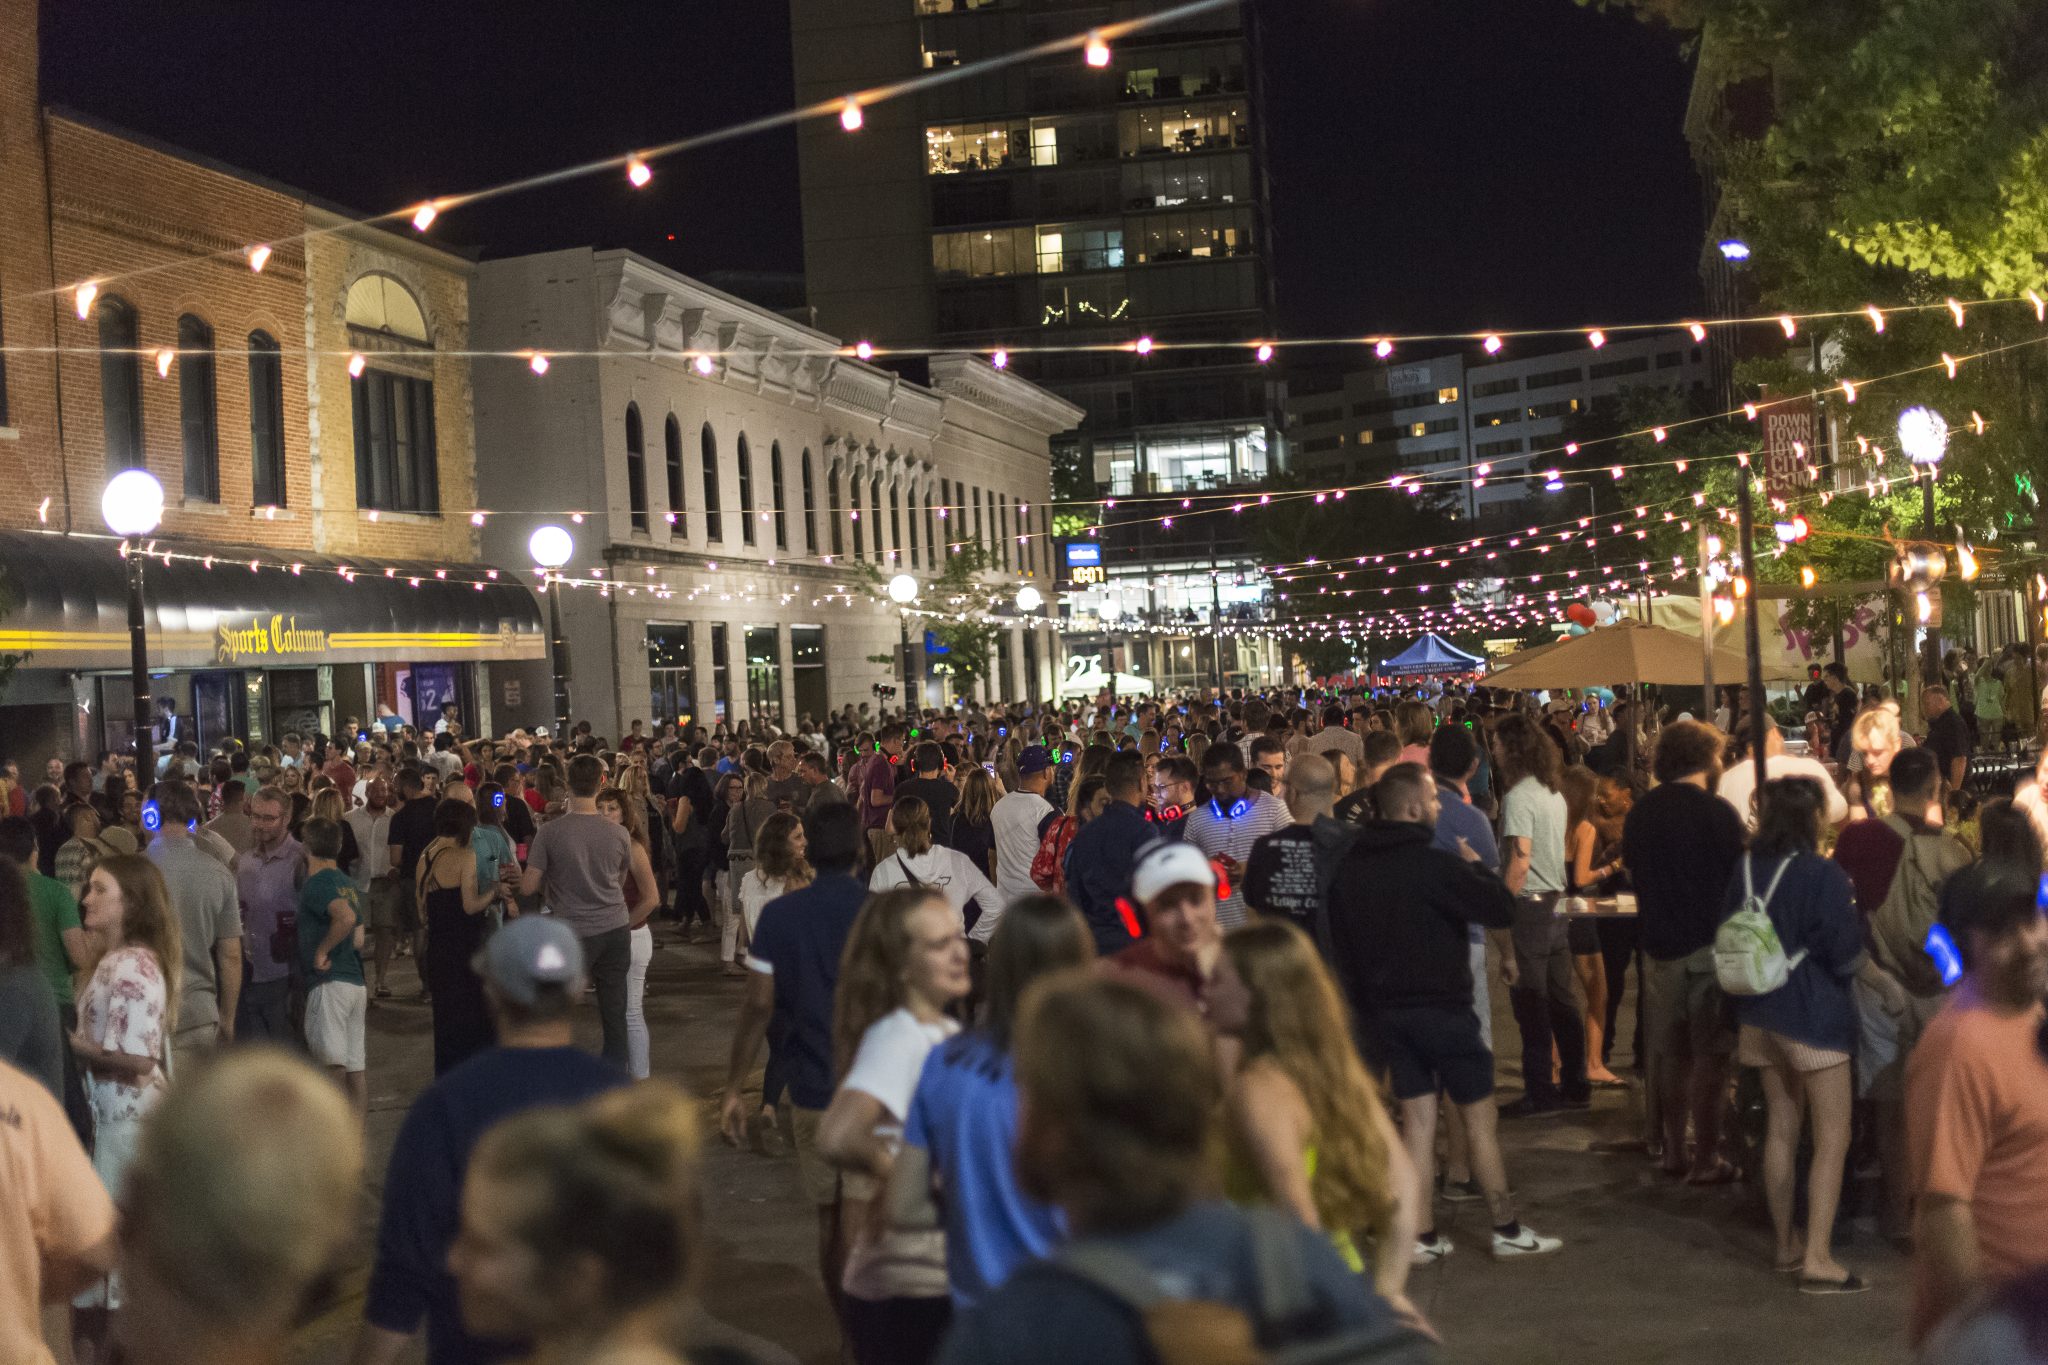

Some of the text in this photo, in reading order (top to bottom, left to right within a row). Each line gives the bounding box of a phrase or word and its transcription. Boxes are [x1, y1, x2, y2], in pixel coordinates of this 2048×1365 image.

[1768, 413, 1811, 428] DOWN
[1768, 426, 1811, 441] TOWN
[1771, 454, 1811, 473] CITY
[1073, 567, 1104, 583] 10:07
[218, 613, 326, 662] Sports Column
